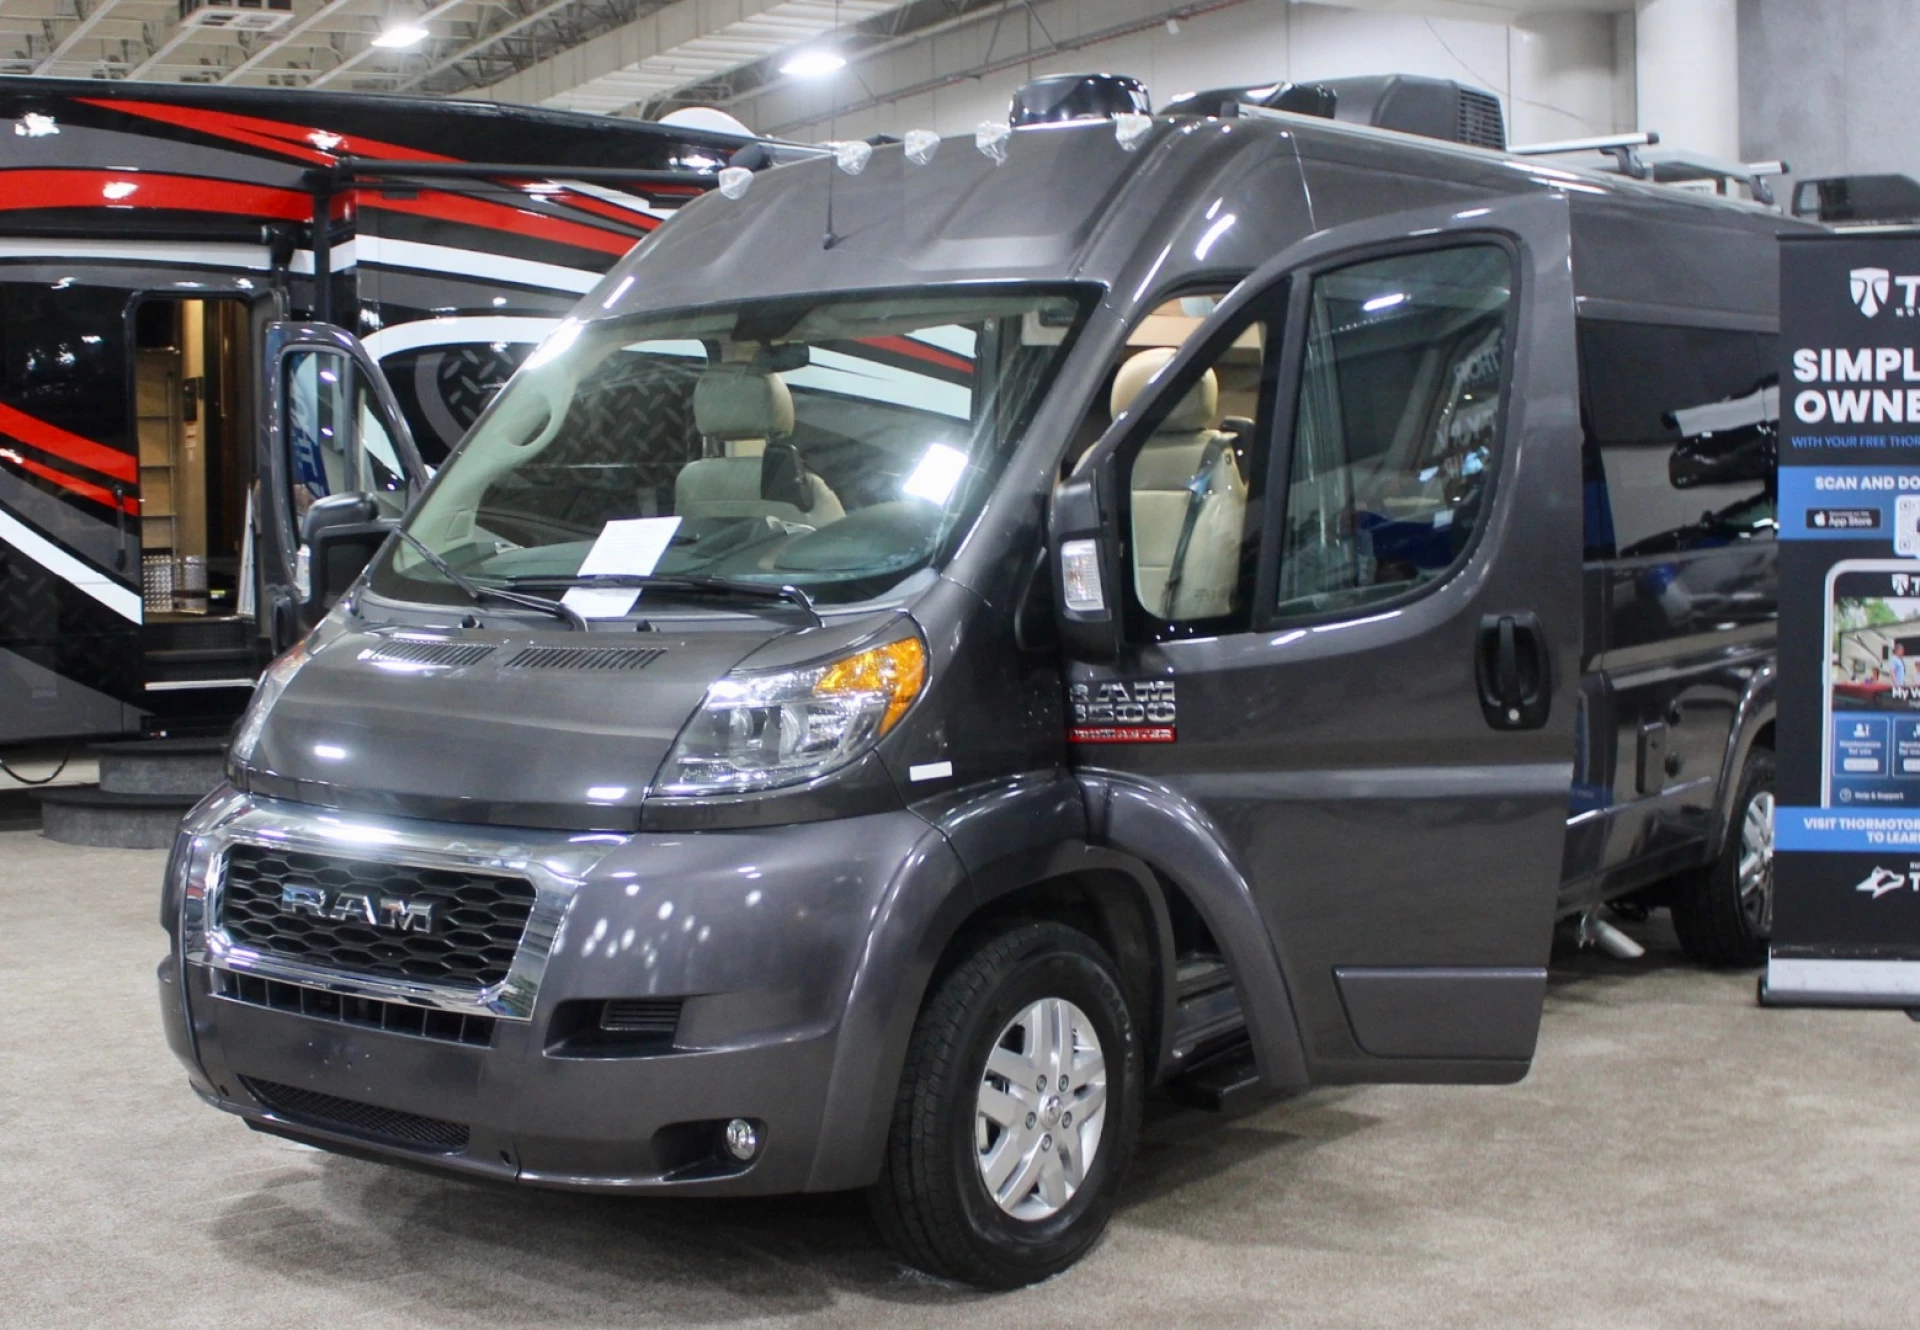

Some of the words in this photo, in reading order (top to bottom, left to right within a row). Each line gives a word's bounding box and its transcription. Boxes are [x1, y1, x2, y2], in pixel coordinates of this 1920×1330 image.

[1793, 348, 1920, 383] SIMPL
[1794, 389, 1920, 424] OWNE
[1791, 435, 1822, 448] WITH
[1825, 435, 1857, 448] YOUR
[1859, 435, 1886, 448] FREE
[1815, 476, 1858, 490] SCAN
[1861, 476, 1895, 490] AND
[1898, 476, 1920, 490] DO
[1828, 516, 1847, 528] App
[1848, 515, 1873, 527] Store
[1069, 681, 1176, 702] RAM
[1892, 687, 1909, 700] My
[1803, 818, 1837, 830] VISIT
[1866, 832, 1884, 844] TO
[281, 883, 433, 934] RAM
